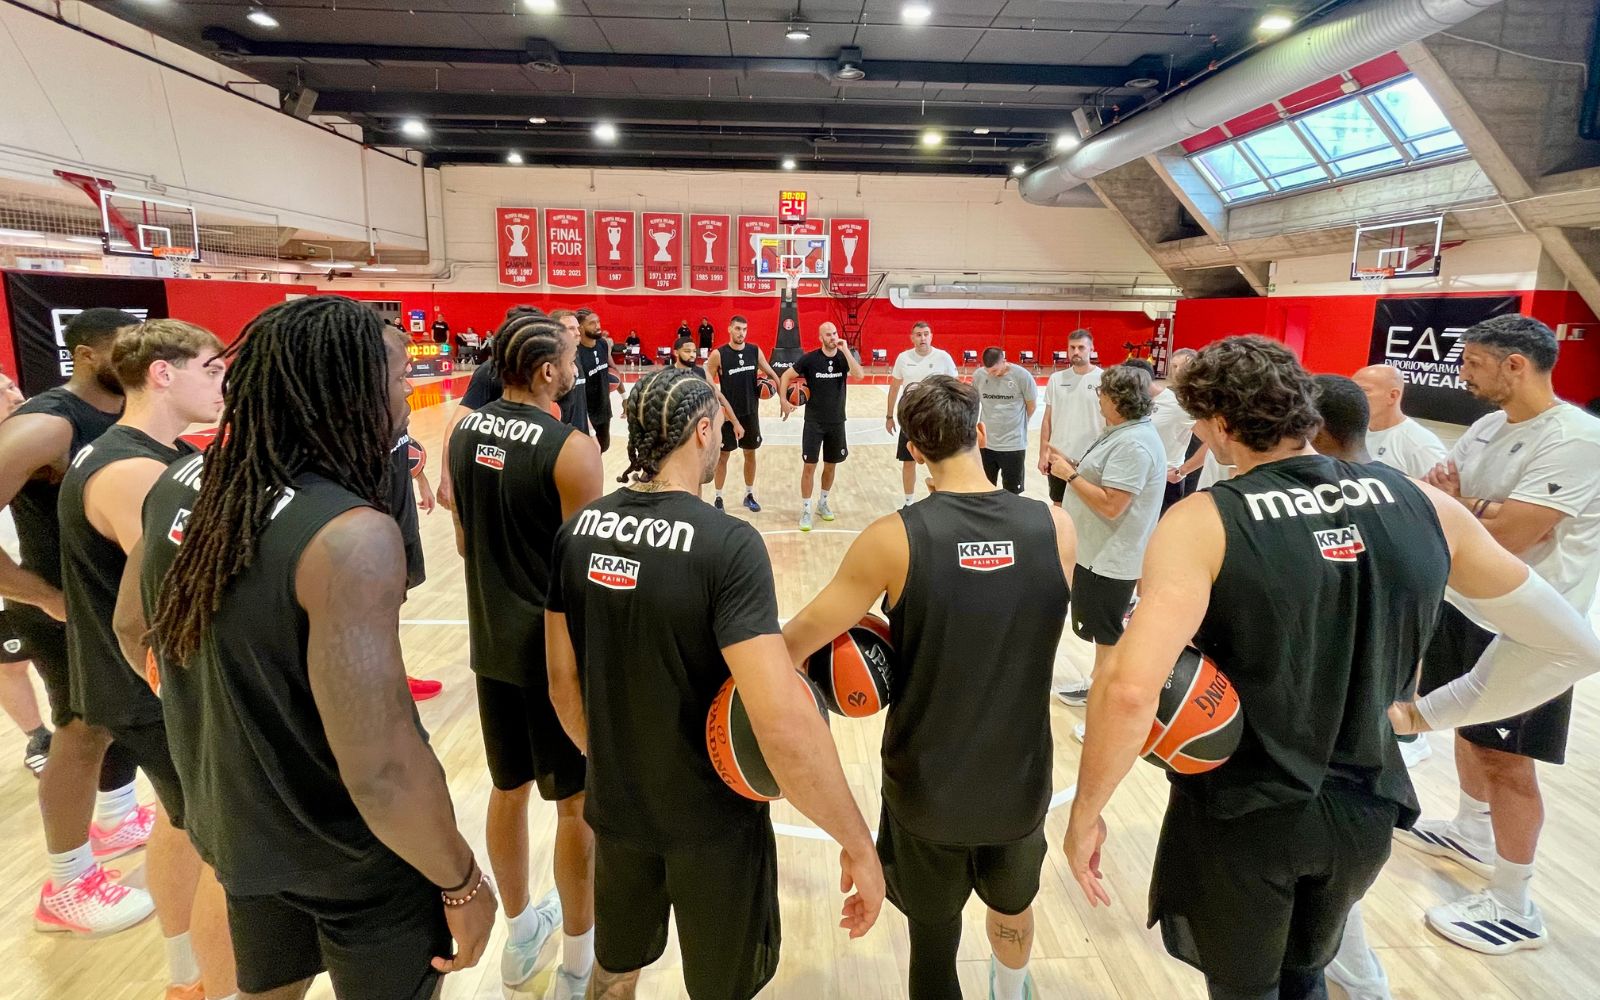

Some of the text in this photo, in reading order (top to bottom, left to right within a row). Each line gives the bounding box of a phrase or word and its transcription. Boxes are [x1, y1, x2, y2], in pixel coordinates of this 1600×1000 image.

[782, 192, 806, 200] 30:00
[782, 201, 805, 215] 24
[550, 228, 582, 241] FINAL
[551, 242, 582, 256] FOUR
[1385, 326, 1468, 362] EA7
[1384, 359, 1464, 374] EMPORIO ARMA
[1402, 371, 1468, 390] EWEAR
[460, 412, 544, 445] macron
[572, 509, 695, 552] macron
[1316, 526, 1355, 548] KRA
[959, 543, 1011, 557] KRAFT
[591, 555, 639, 577] KRAFT
[1194, 671, 1229, 719] DING
